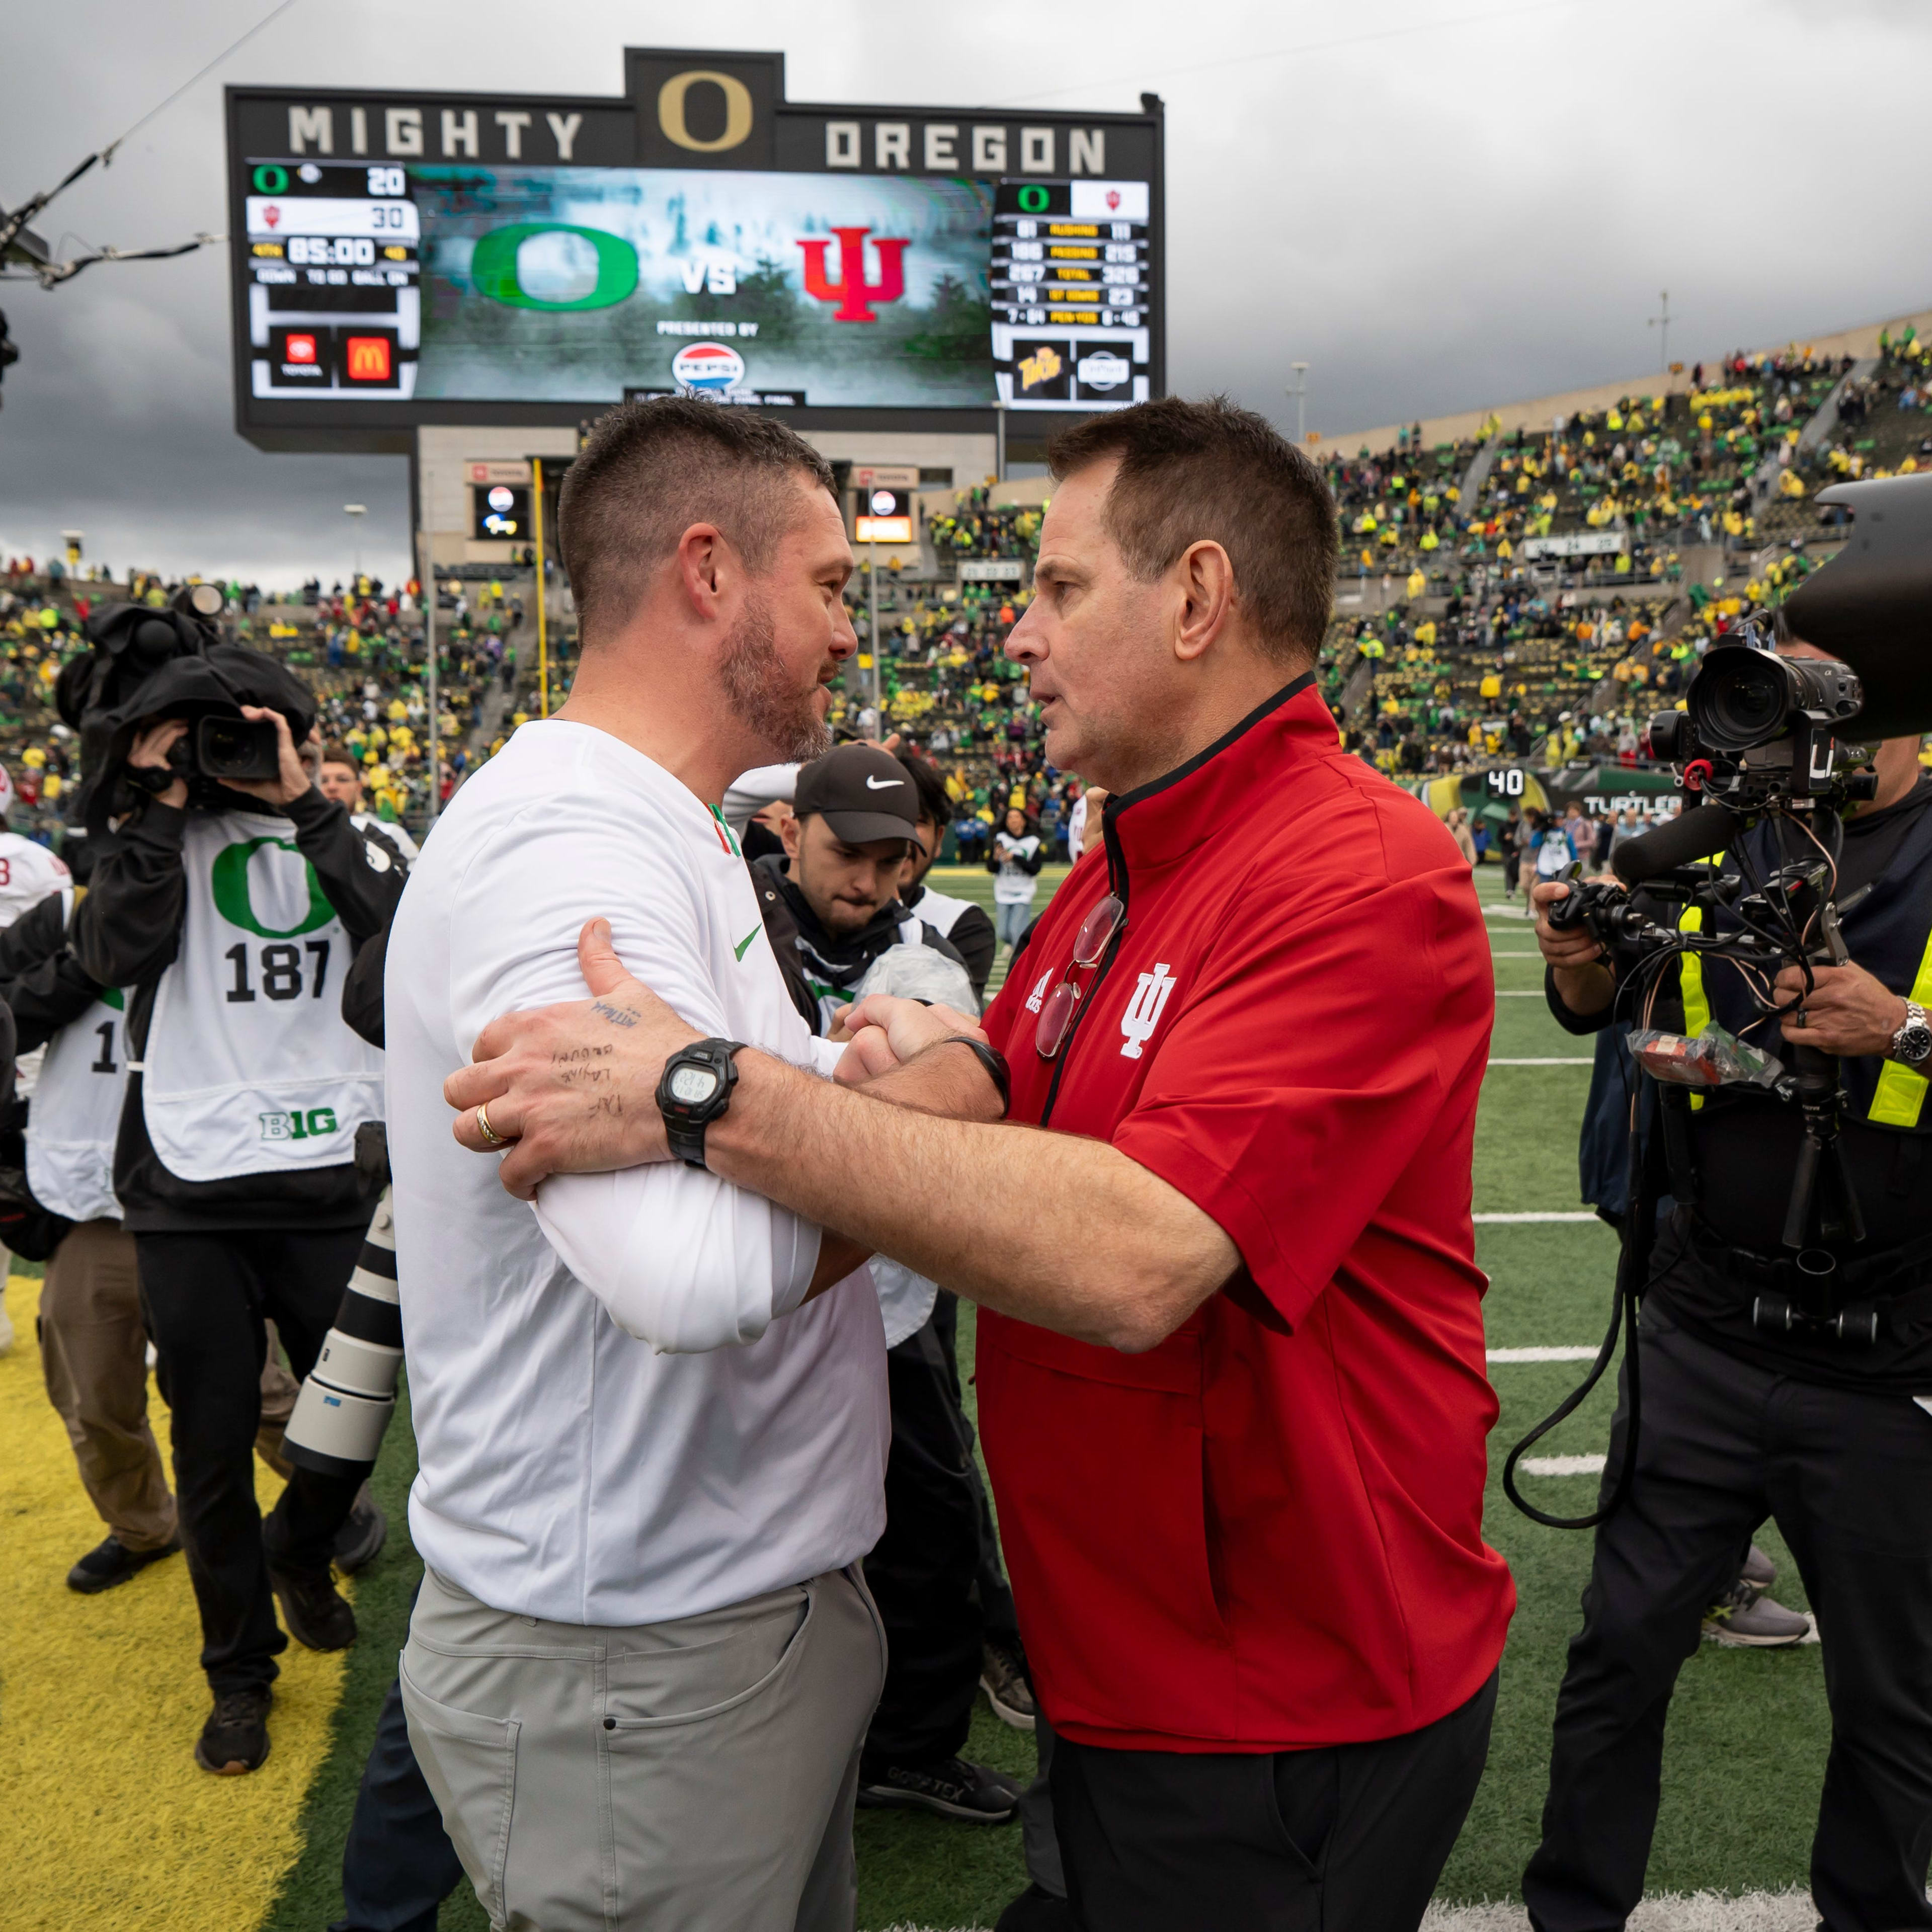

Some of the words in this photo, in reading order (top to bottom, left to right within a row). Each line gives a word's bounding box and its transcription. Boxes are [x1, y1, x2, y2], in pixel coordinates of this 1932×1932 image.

[658, 69, 753, 152] O
[288, 106, 583, 160] MIGHTY
[825, 121, 1105, 174] OREGON
[367, 167, 406, 196] 20
[371, 207, 404, 228] 30
[256, 268, 297, 284] DOWN
[306, 269, 326, 285] TO
[327, 269, 348, 285] GO
[352, 270, 387, 285] BALL
[387, 270, 409, 286] ON
[472, 223, 639, 311] O
[680, 261, 737, 294] VS
[1056, 268, 1092, 280] TOTAL
[657, 321, 737, 336] PRESENTED
[738, 322, 759, 337] BY
[280, 364, 323, 377] TOYOTA
[680, 364, 738, 372] PEPSI
[1489, 770, 1523, 795] 40
[225, 939, 331, 1002] 187
[92, 1021, 117, 1073] 1
